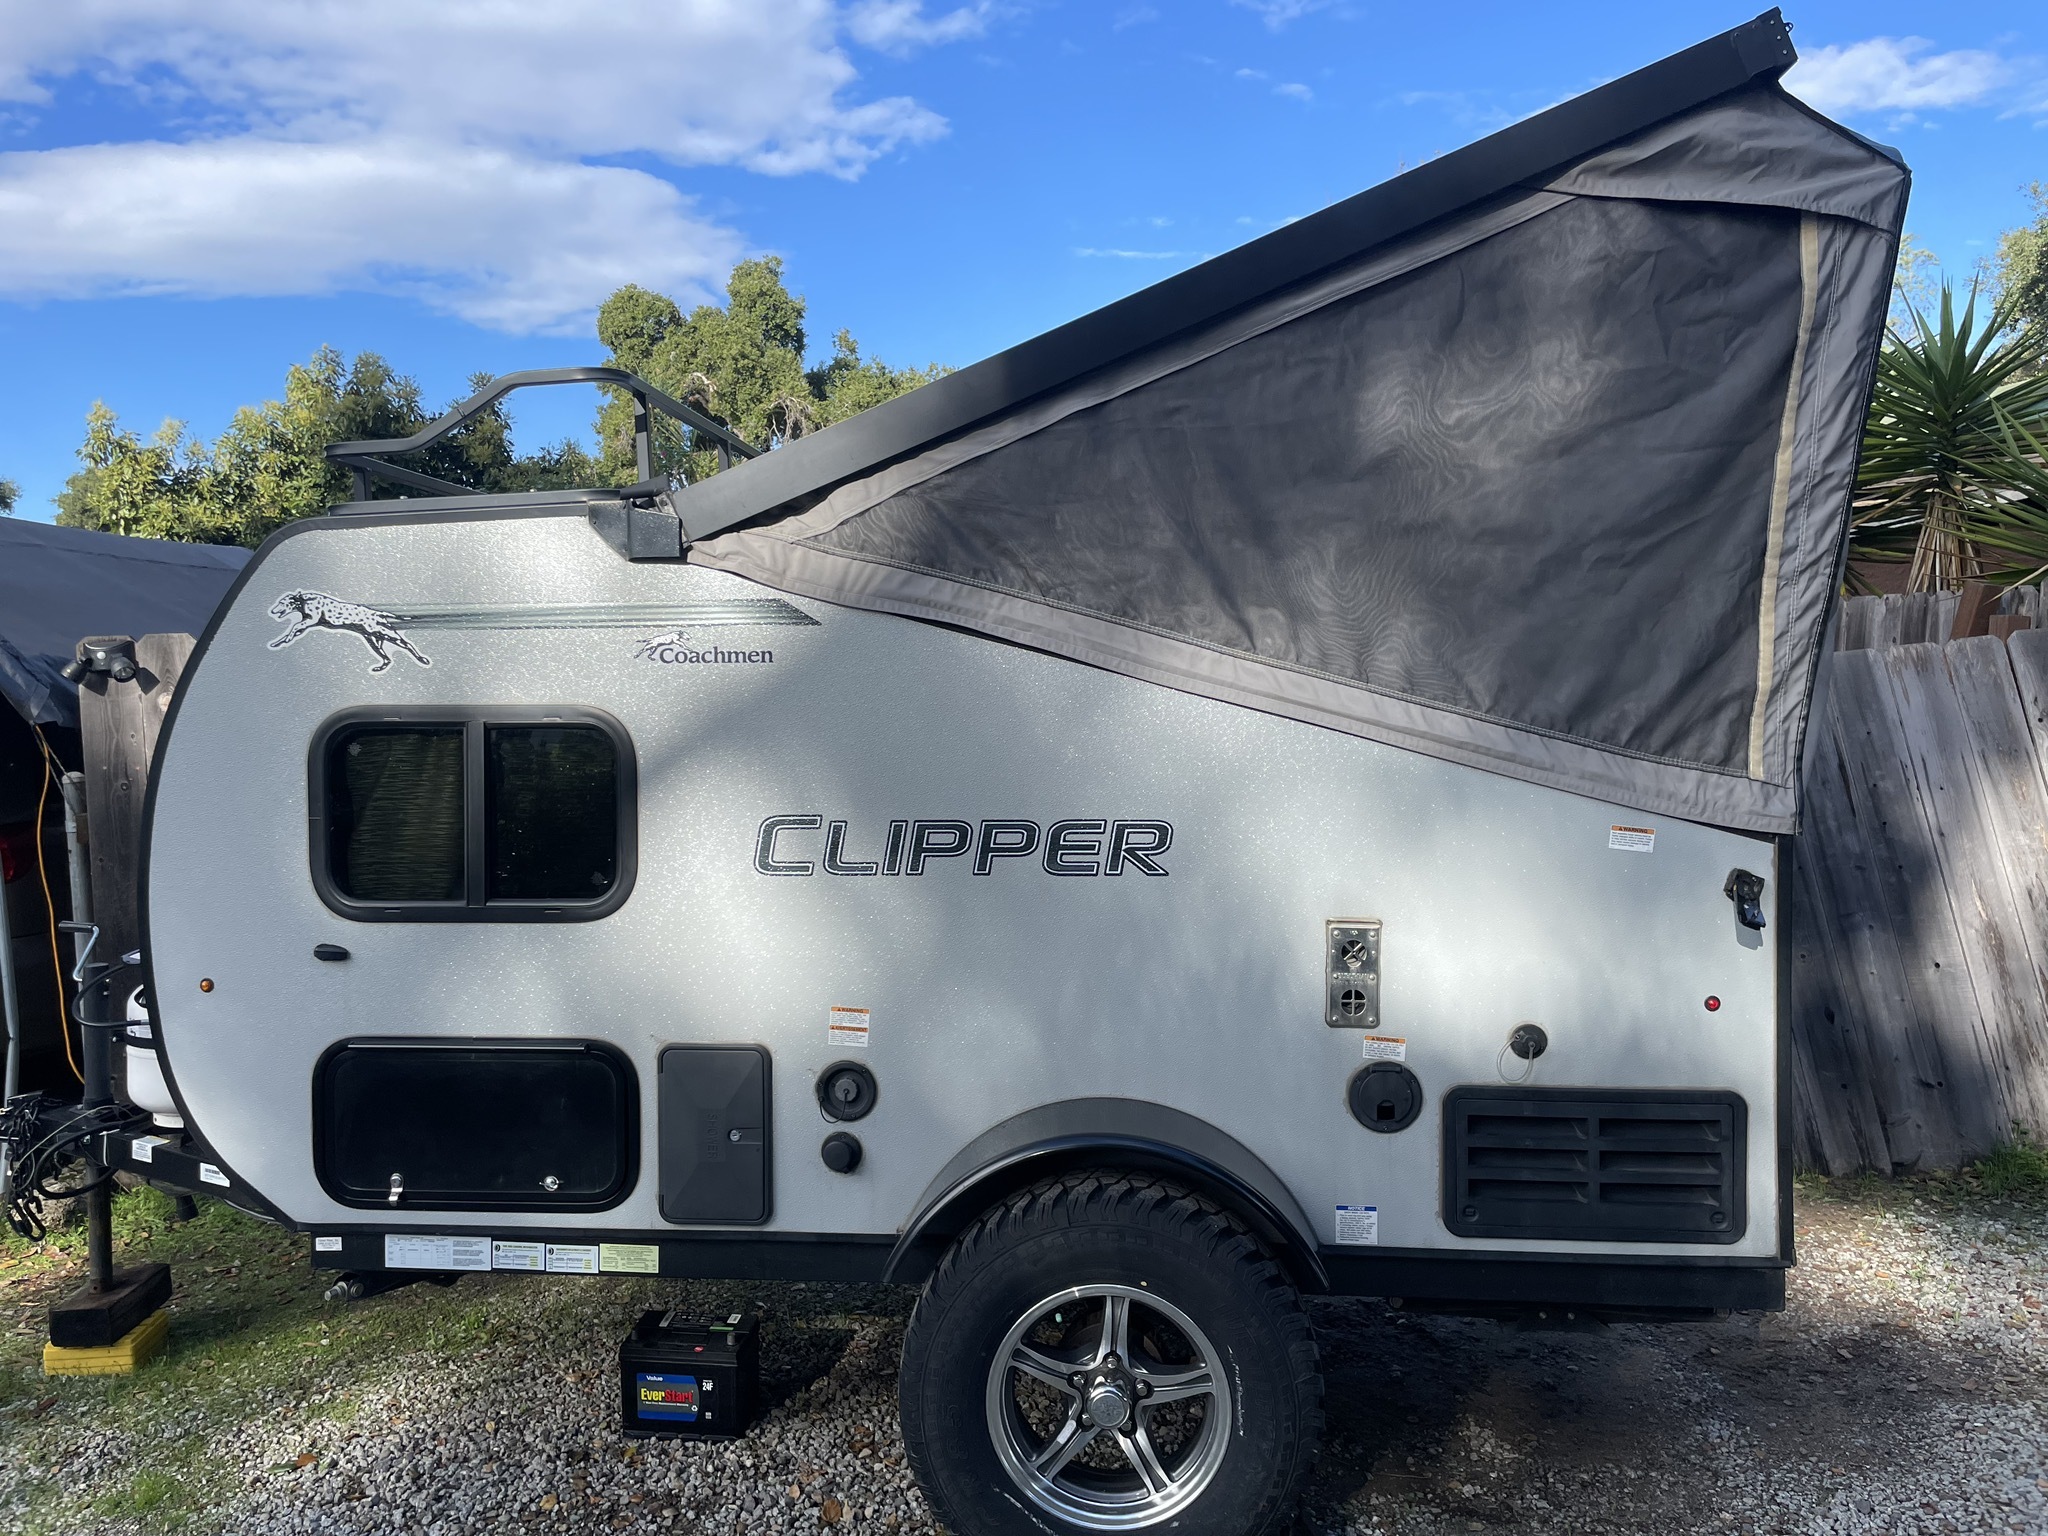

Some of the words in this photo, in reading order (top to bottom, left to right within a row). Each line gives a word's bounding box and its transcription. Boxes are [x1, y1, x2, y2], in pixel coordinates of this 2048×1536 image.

[659, 646, 774, 664] Coachmen
[753, 814, 1173, 876] CLIPPER
[706, 1112, 720, 1161] SHOWER
[641, 1388, 694, 1403] EverStart
[702, 1382, 714, 1392] 24F
